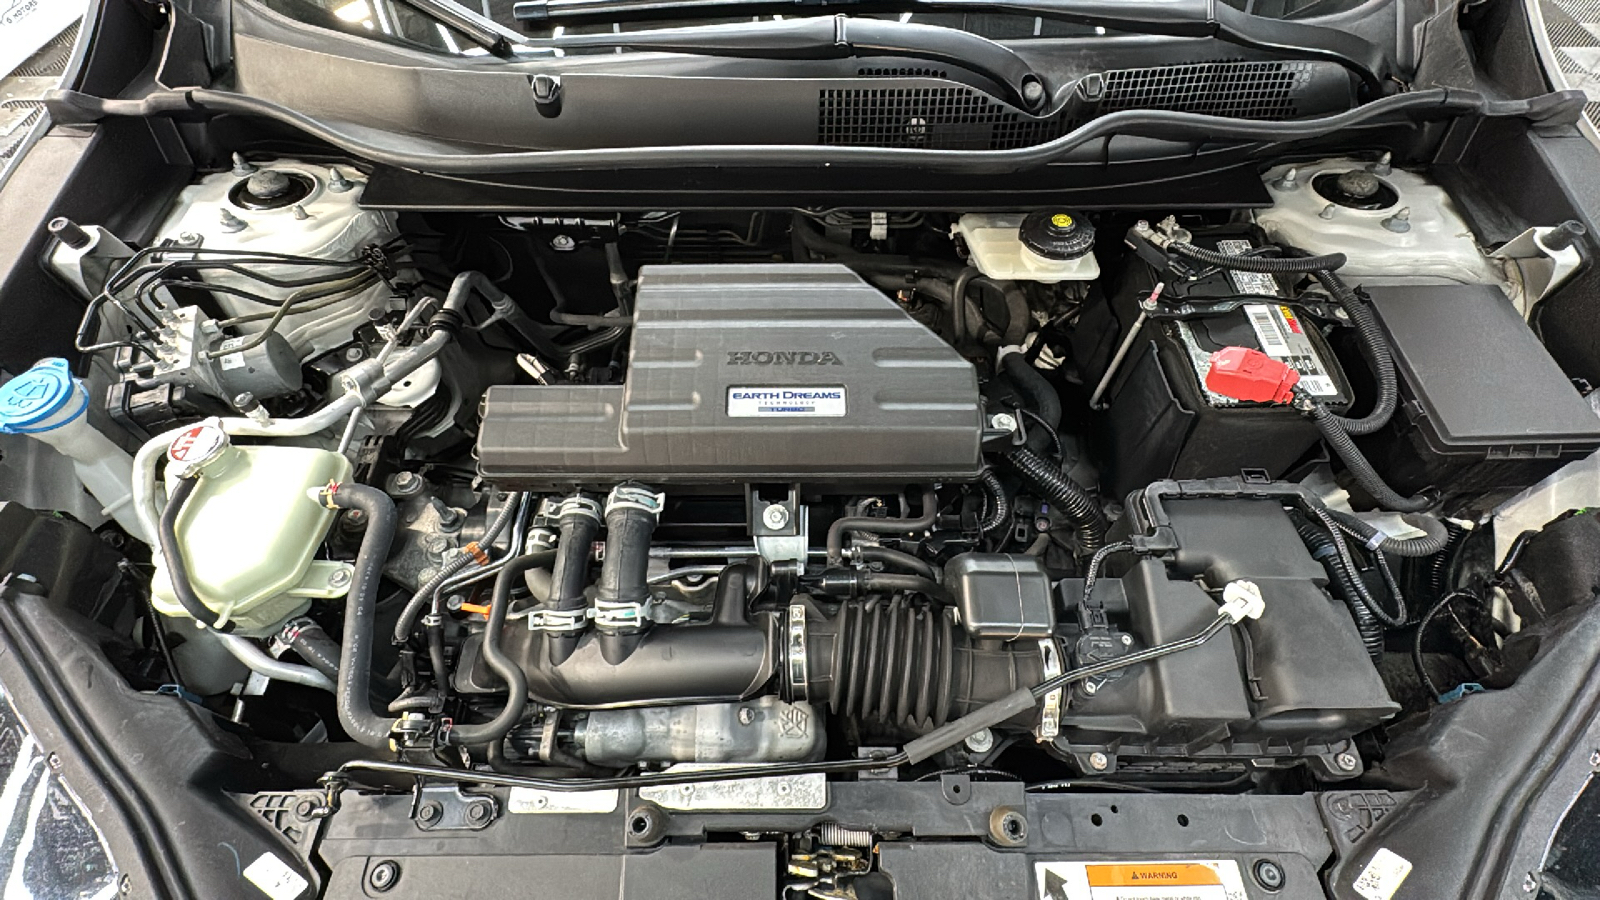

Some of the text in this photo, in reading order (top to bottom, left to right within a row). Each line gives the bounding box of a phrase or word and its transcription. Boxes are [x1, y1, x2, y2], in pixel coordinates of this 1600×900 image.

[727, 351, 844, 365] HONDA
[783, 391, 841, 399] DREAMS
[1139, 871, 1178, 879] WARNING
